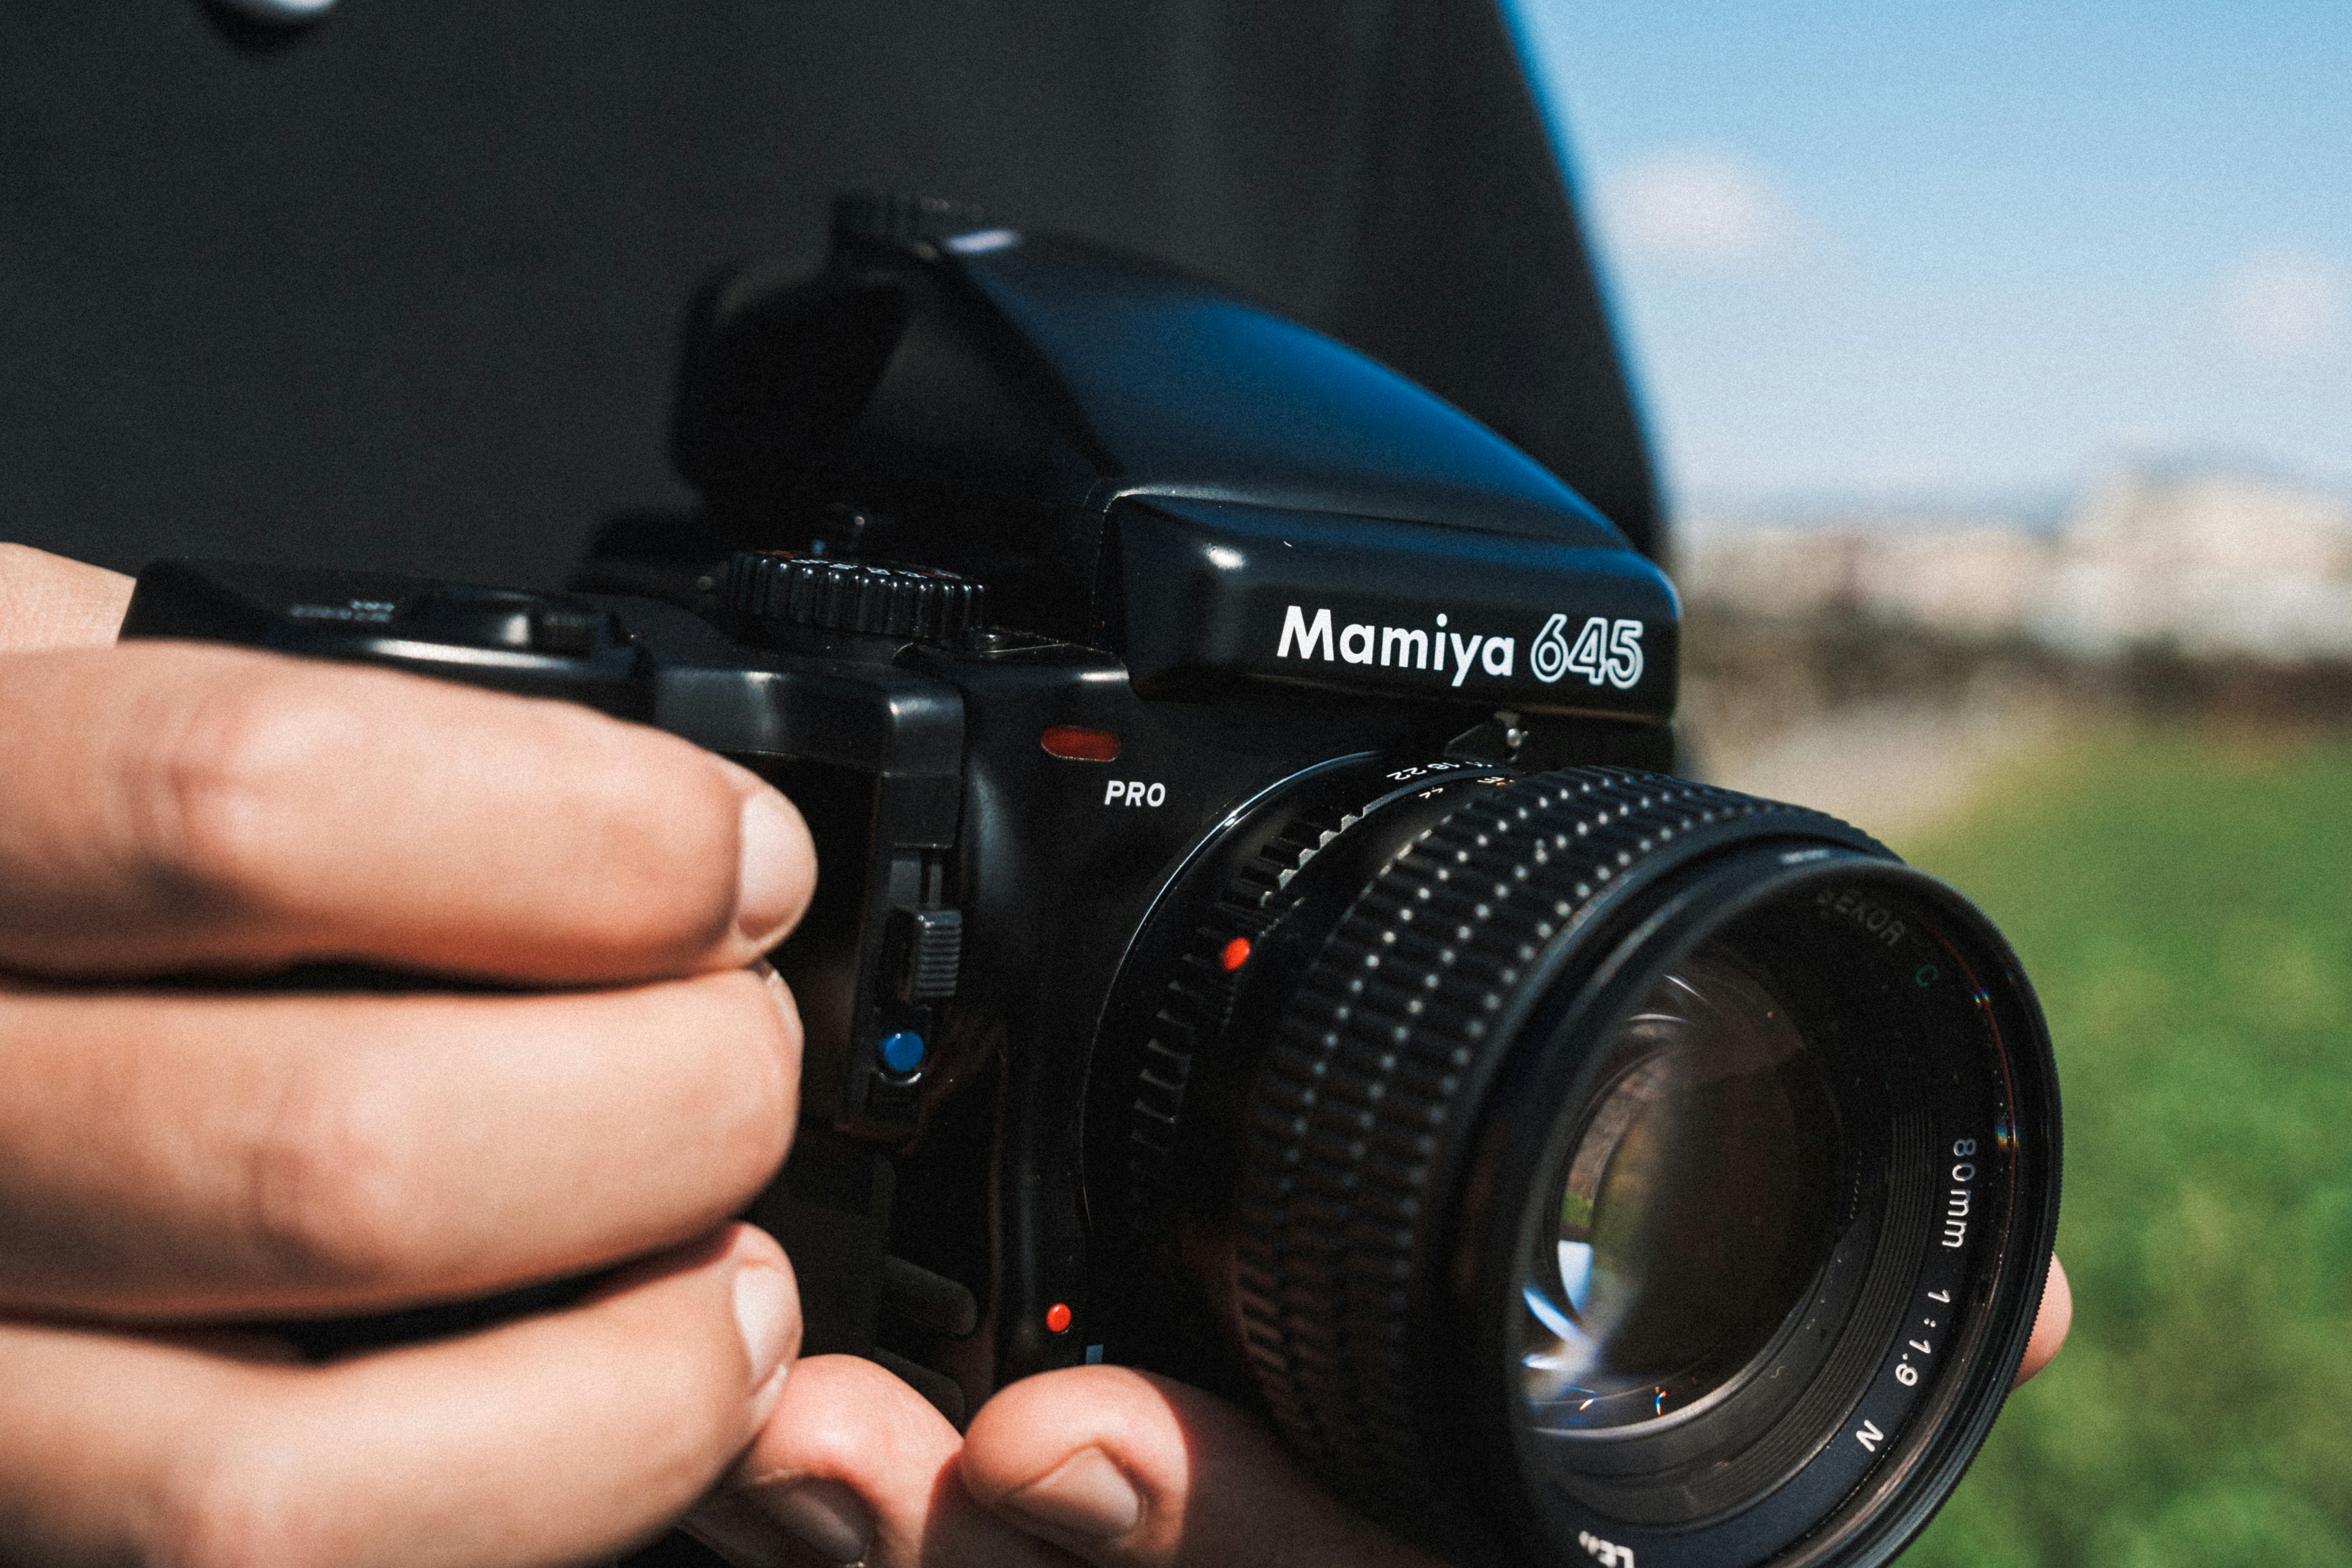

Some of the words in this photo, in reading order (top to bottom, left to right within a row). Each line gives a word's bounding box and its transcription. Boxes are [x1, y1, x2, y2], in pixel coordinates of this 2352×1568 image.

[1277, 605, 1515, 687] Mamiya
[1530, 613, 1644, 689] 645
[1386, 767, 1427, 780] 22
[1104, 780, 1165, 807] PRO
[1915, 964, 1940, 987] C
[1942, 1138, 1977, 1249] 80mm
[1856, 1419, 1884, 1452] N
